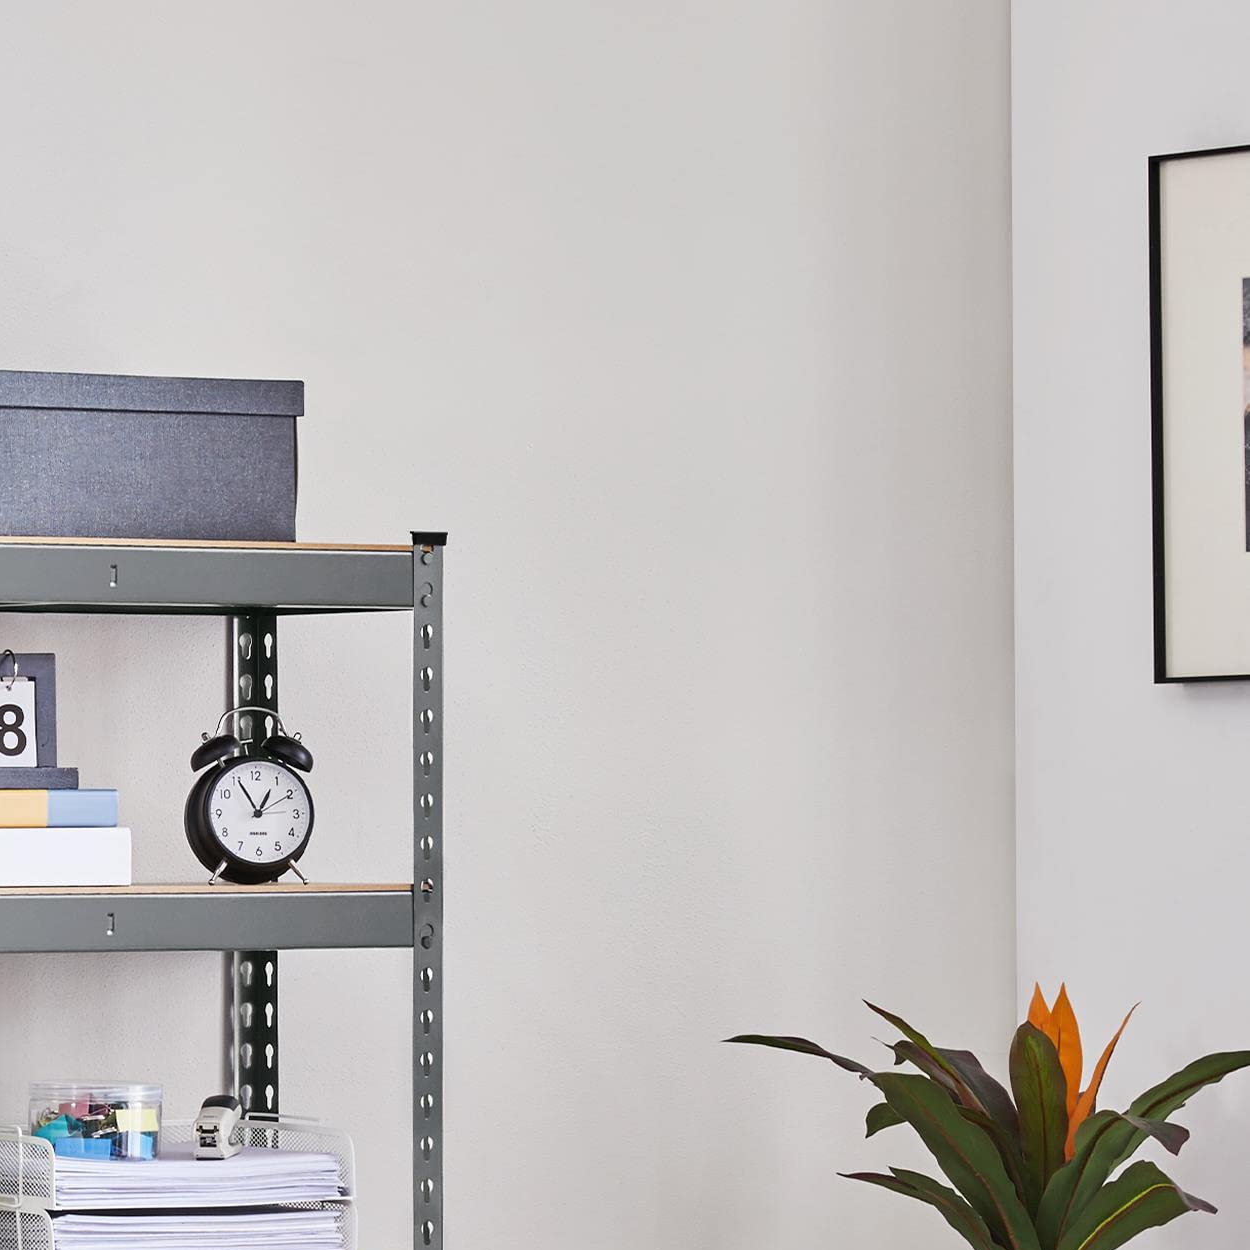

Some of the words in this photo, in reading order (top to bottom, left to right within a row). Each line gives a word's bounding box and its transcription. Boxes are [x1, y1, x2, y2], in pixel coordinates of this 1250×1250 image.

[250, 770, 261, 781] 12
[220, 789, 231, 799] 10
[286, 789, 293, 799] 2
[215, 809, 222, 819] 9
[292, 809, 300, 819] 3
[221, 827, 229, 837] 8
[288, 827, 295, 837] 4
[237, 841, 244, 851] 7
[274, 841, 282, 851] 5
[255, 846, 262, 857] 6
